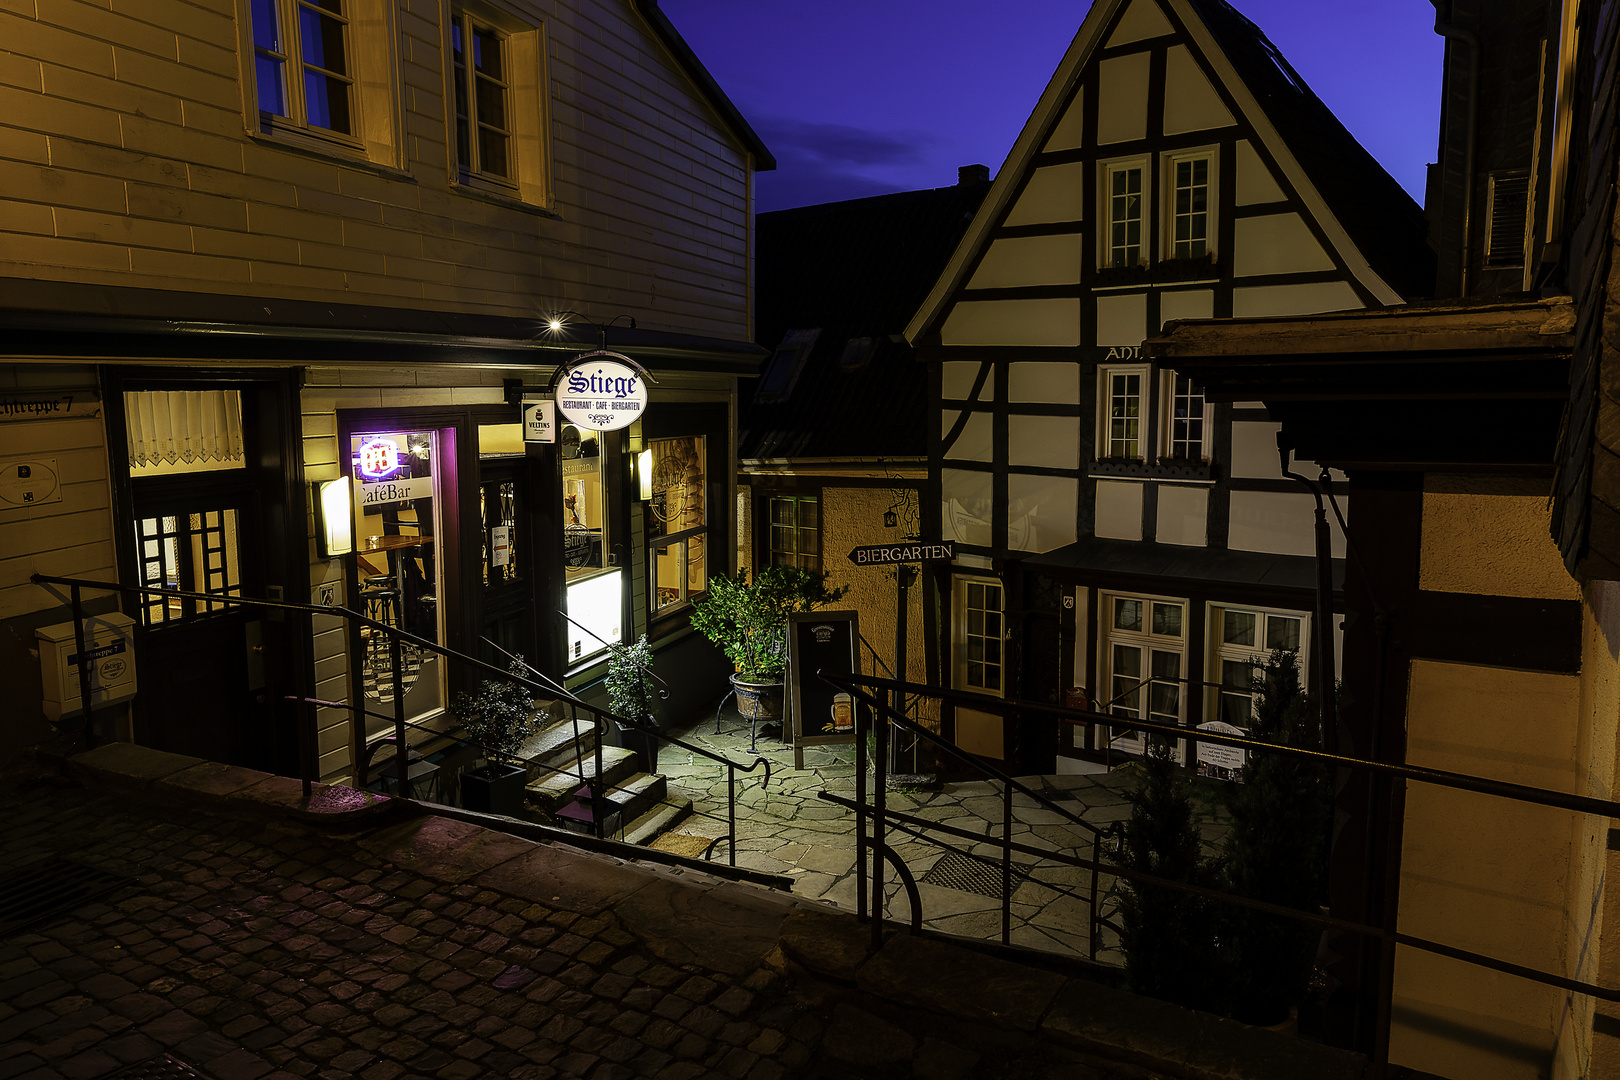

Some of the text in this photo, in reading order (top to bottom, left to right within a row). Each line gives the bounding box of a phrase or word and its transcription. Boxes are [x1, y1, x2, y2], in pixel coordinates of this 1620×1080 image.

[568, 369, 637, 398] Stiege
[62, 395, 74, 412] 7
[562, 400, 641, 411] RESTAURANT CAFE BIERGARTEN
[528, 421, 550, 429] VELTINS
[562, 462, 593, 475] estaurant
[356, 484, 411, 504] CaféBar
[857, 544, 953, 563] BIERGARTEN
